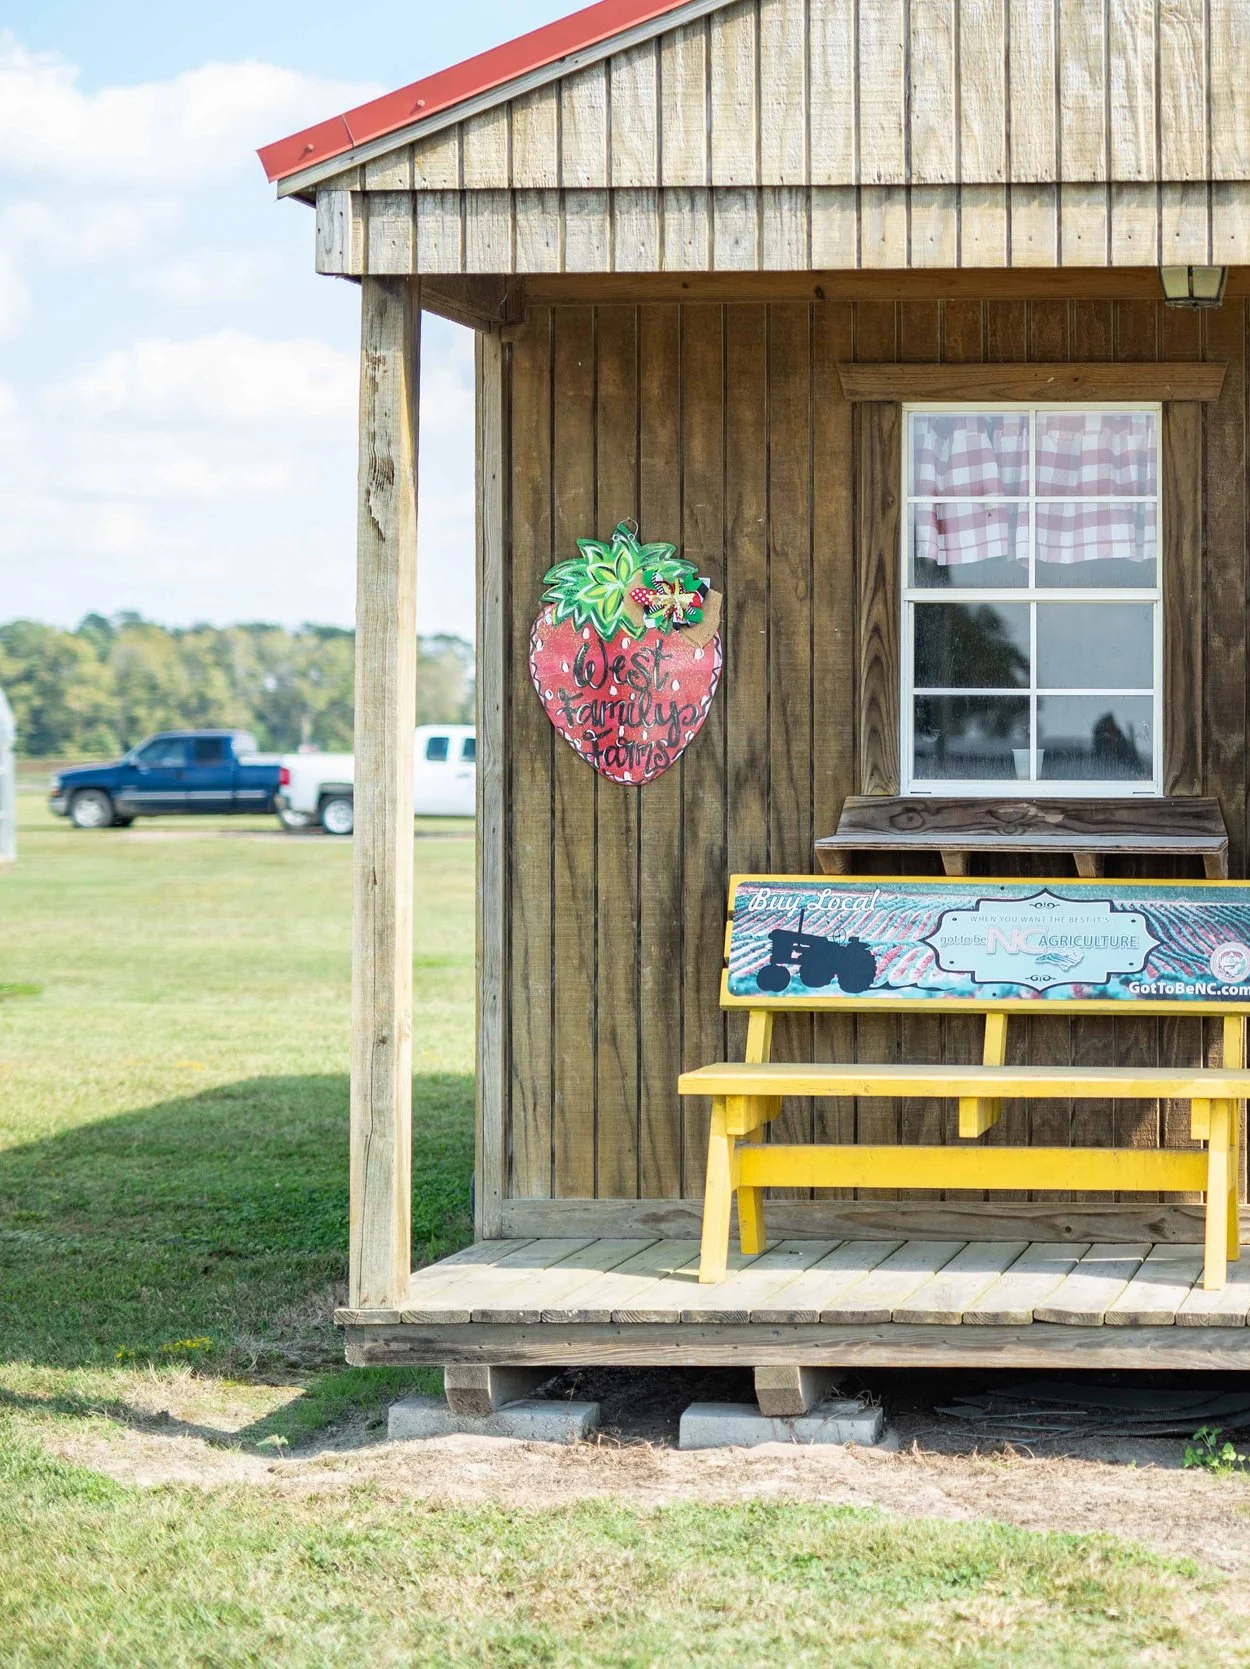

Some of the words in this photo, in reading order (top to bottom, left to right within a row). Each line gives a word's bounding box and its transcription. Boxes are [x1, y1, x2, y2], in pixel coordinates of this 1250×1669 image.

[573, 638, 673, 692] West
[748, 887, 801, 918] Buy
[807, 888, 881, 911] Local
[970, 915, 997, 923] WHEN
[999, 915, 1018, 923] YOU
[1049, 916, 1065, 924] THE
[1069, 916, 1089, 924] BEST
[940, 934, 959, 946] got
[960, 935, 971, 944] to
[973, 934, 987, 944] be
[986, 926, 1049, 955] NC
[1038, 935, 1139, 948] AGRICULTURE
